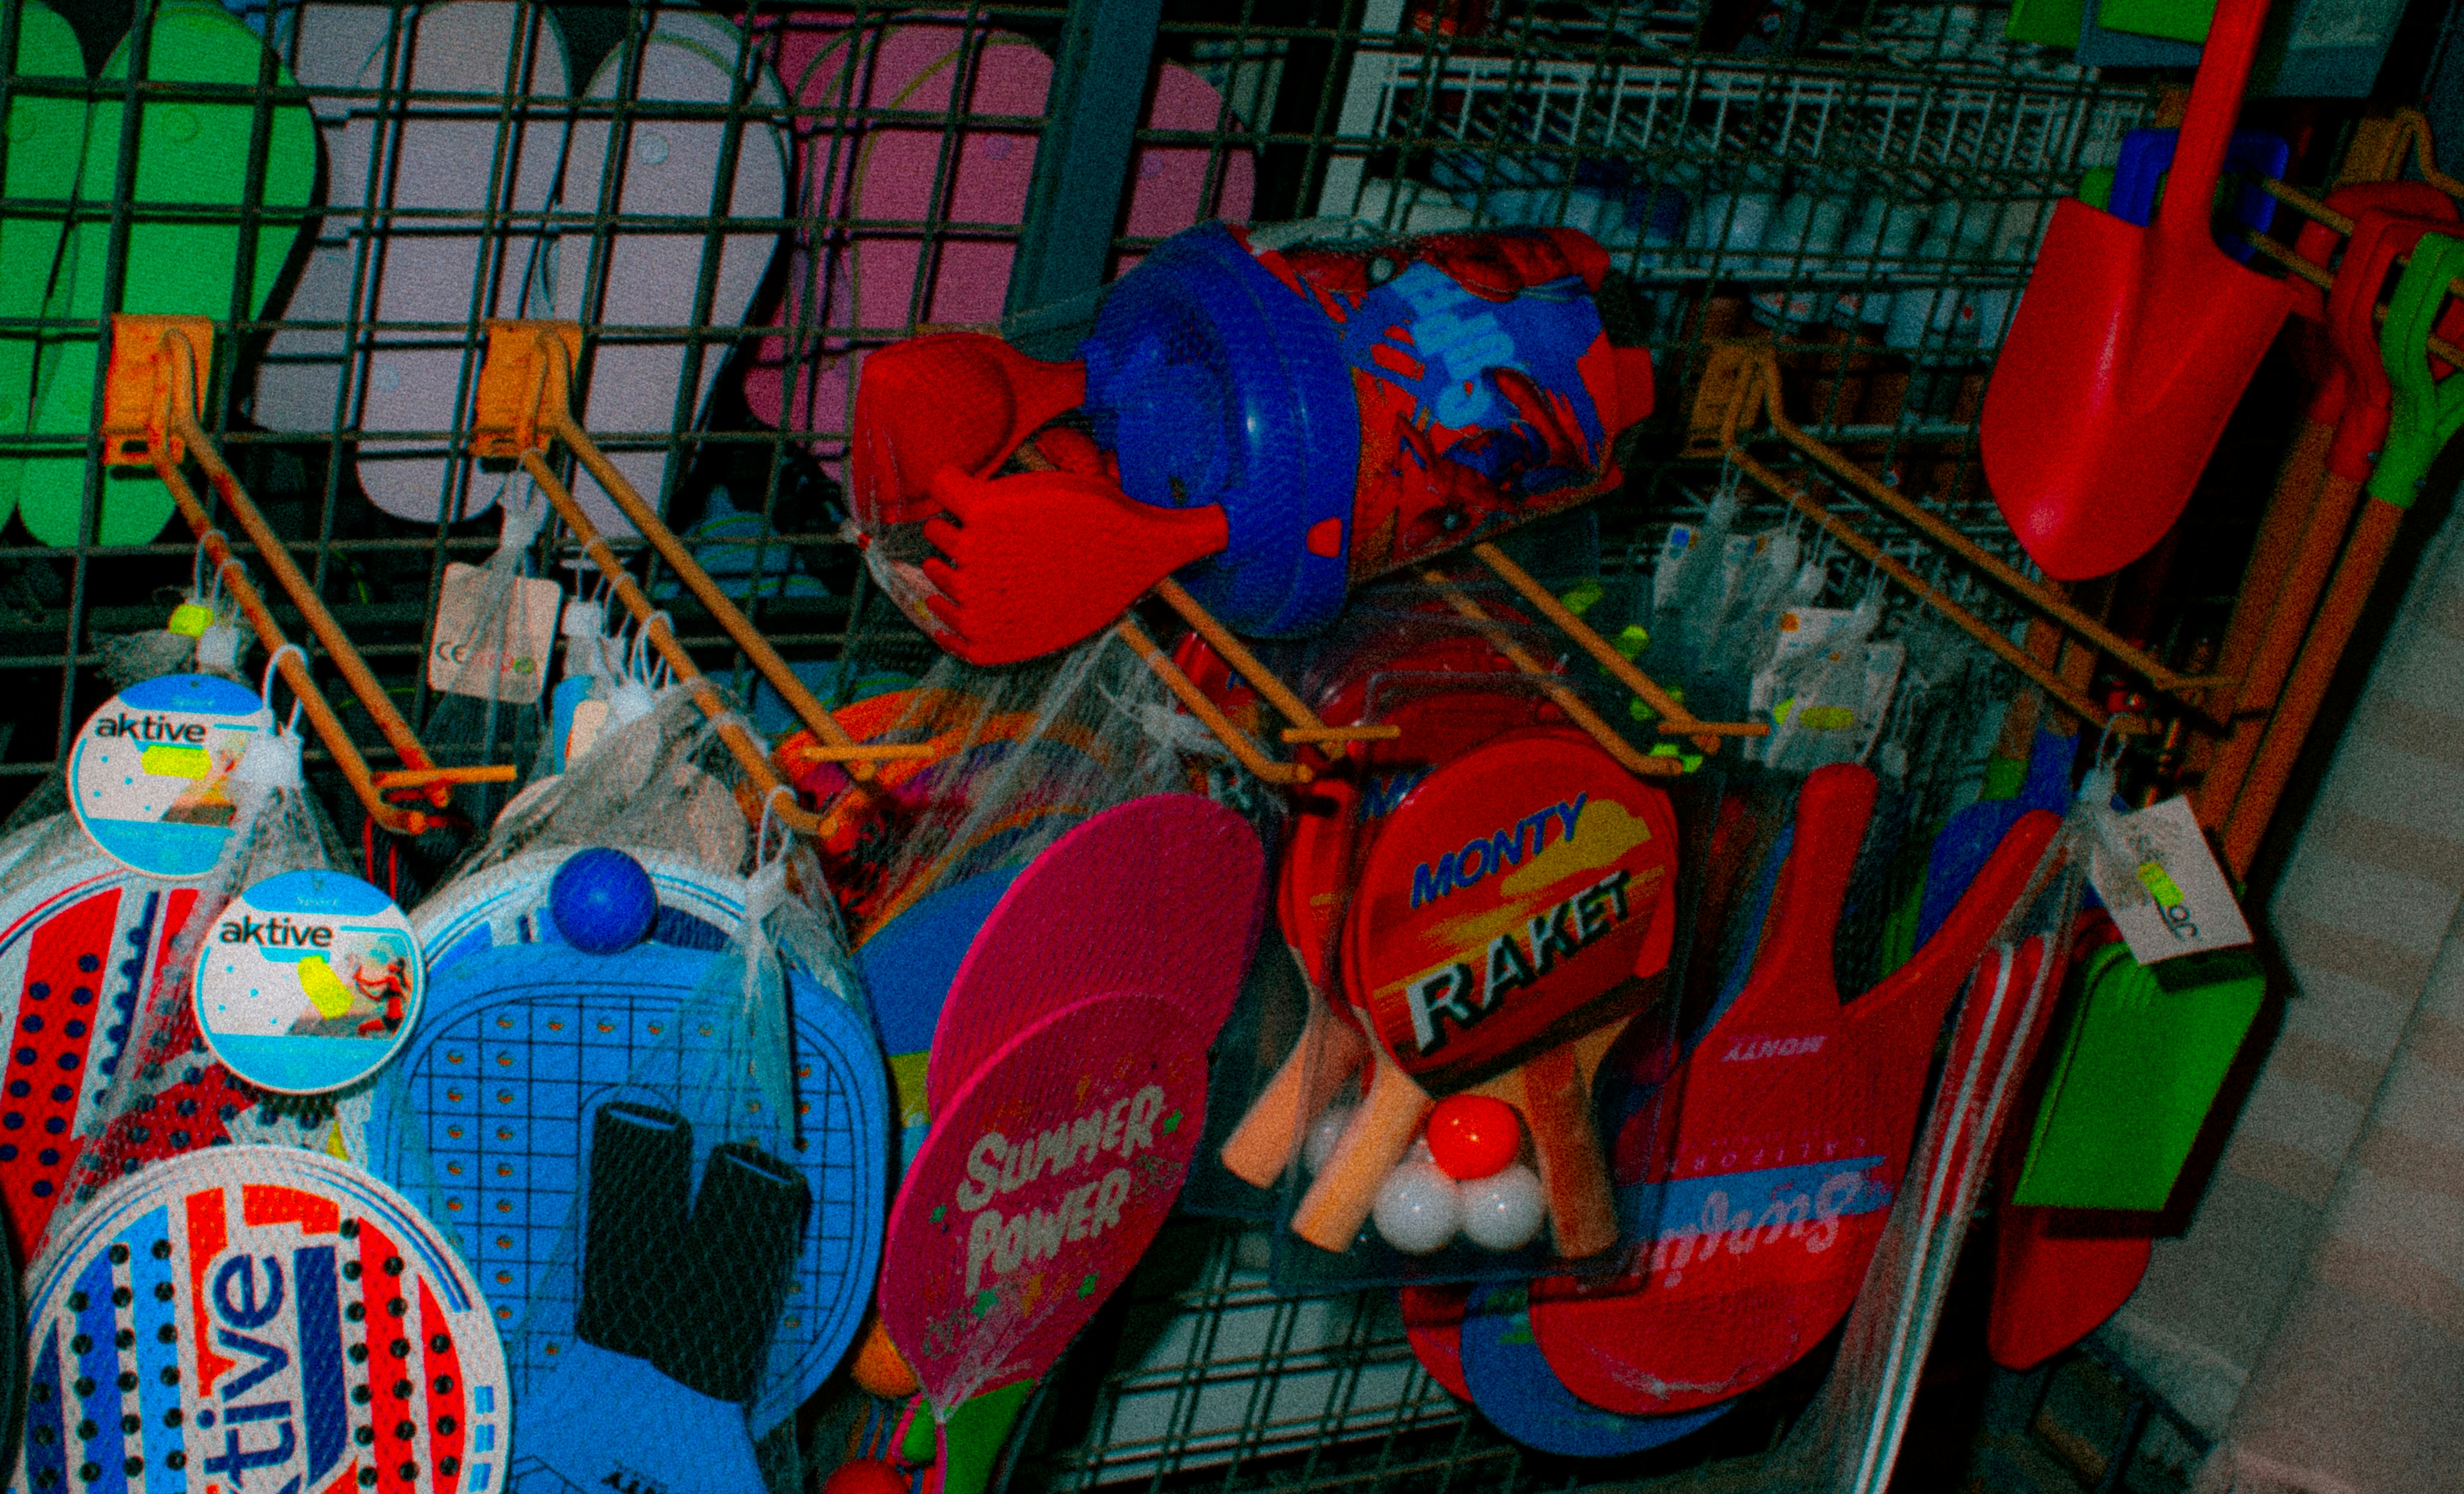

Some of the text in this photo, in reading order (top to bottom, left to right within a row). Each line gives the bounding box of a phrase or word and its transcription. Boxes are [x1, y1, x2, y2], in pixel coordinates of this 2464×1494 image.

[95, 713, 207, 742] aktive
[1409, 791, 1587, 909] MONTY
[219, 914, 334, 947] aktive
[1405, 870, 1631, 1056] RAKET
[1721, 1034, 1827, 1062] MONTY
[956, 1083, 1167, 1212] SUMMER
[1663, 1137, 1866, 1174] CALIFORN
[964, 1167, 1131, 1298] POWER
[196, 1253, 301, 1494] tive
